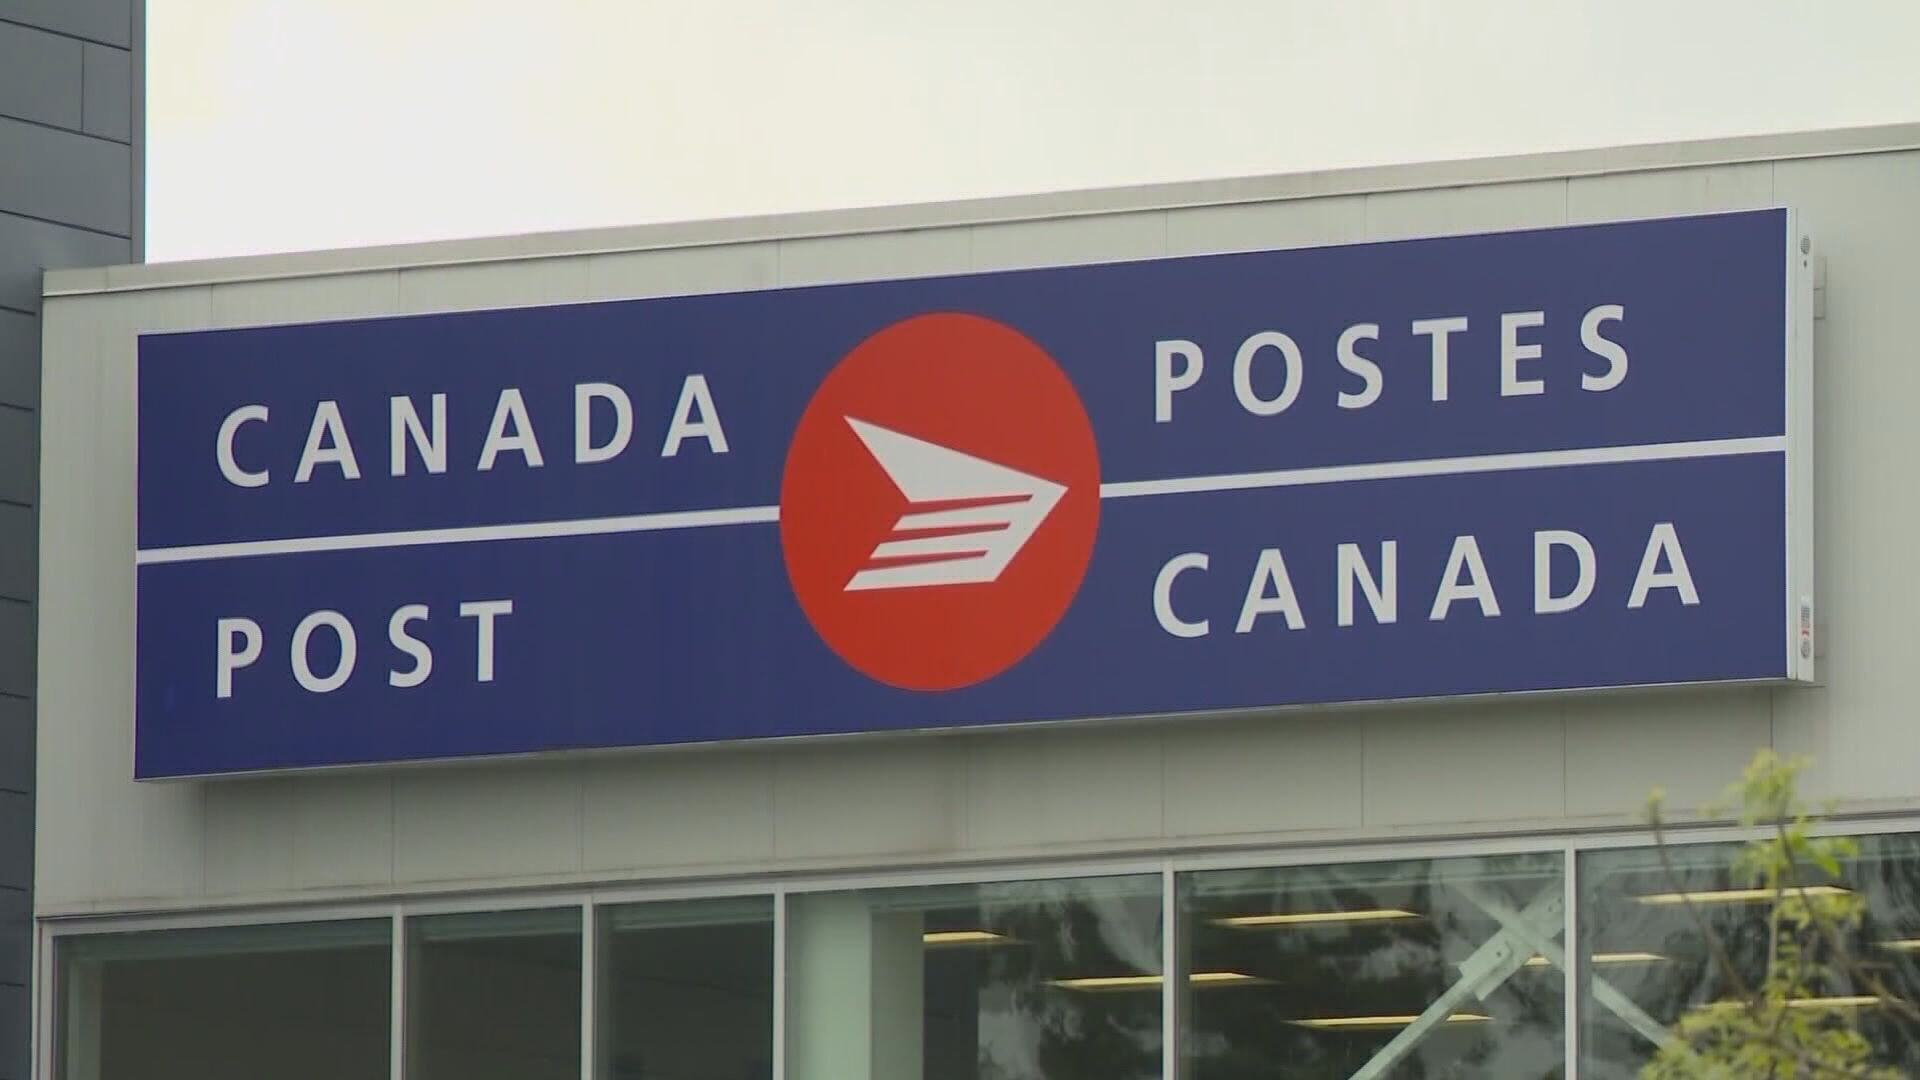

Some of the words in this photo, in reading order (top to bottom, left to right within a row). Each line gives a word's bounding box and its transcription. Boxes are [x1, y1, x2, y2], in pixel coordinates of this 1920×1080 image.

[1155, 304, 1629, 423] POSTES
[216, 375, 730, 487] CANADA
[1153, 523, 1701, 638] CANADA
[216, 600, 514, 699] POST
